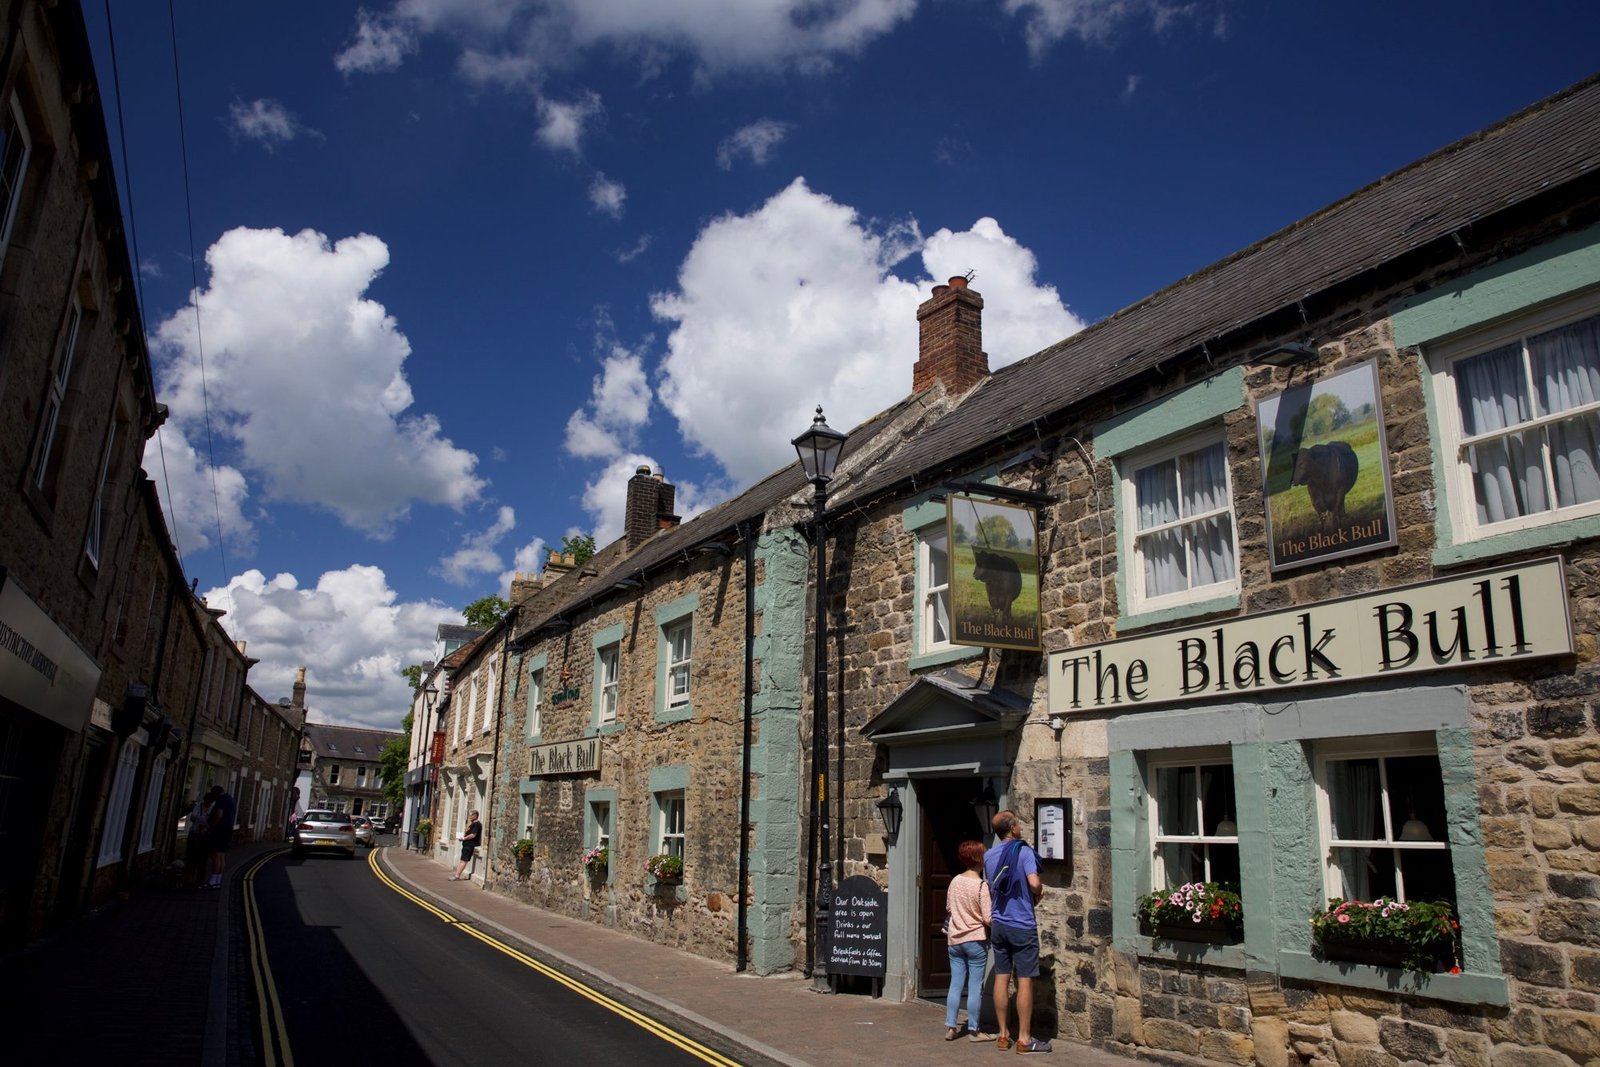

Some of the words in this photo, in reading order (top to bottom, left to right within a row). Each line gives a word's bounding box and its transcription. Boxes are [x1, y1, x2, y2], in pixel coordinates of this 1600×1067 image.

[1279, 541, 1306, 557] The
[1308, 528, 1349, 550] Black
[1351, 519, 1382, 540] Bull
[960, 621, 982, 635] The
[984, 623, 1012, 638] Black
[1014, 627, 1034, 640] Bull
[1062, 650, 1150, 709] The
[1177, 613, 1342, 696] Black
[1372, 574, 1533, 671] Bull
[530, 748, 545, 773] The
[548, 745, 573, 772] Black
[576, 740, 596, 768] Bull
[835, 896, 848, 906] Our
[851, 896, 879, 907] Outside
[835, 919, 854, 929] Drinks
[850, 909, 857, 917] is
[858, 911, 874, 920] open
